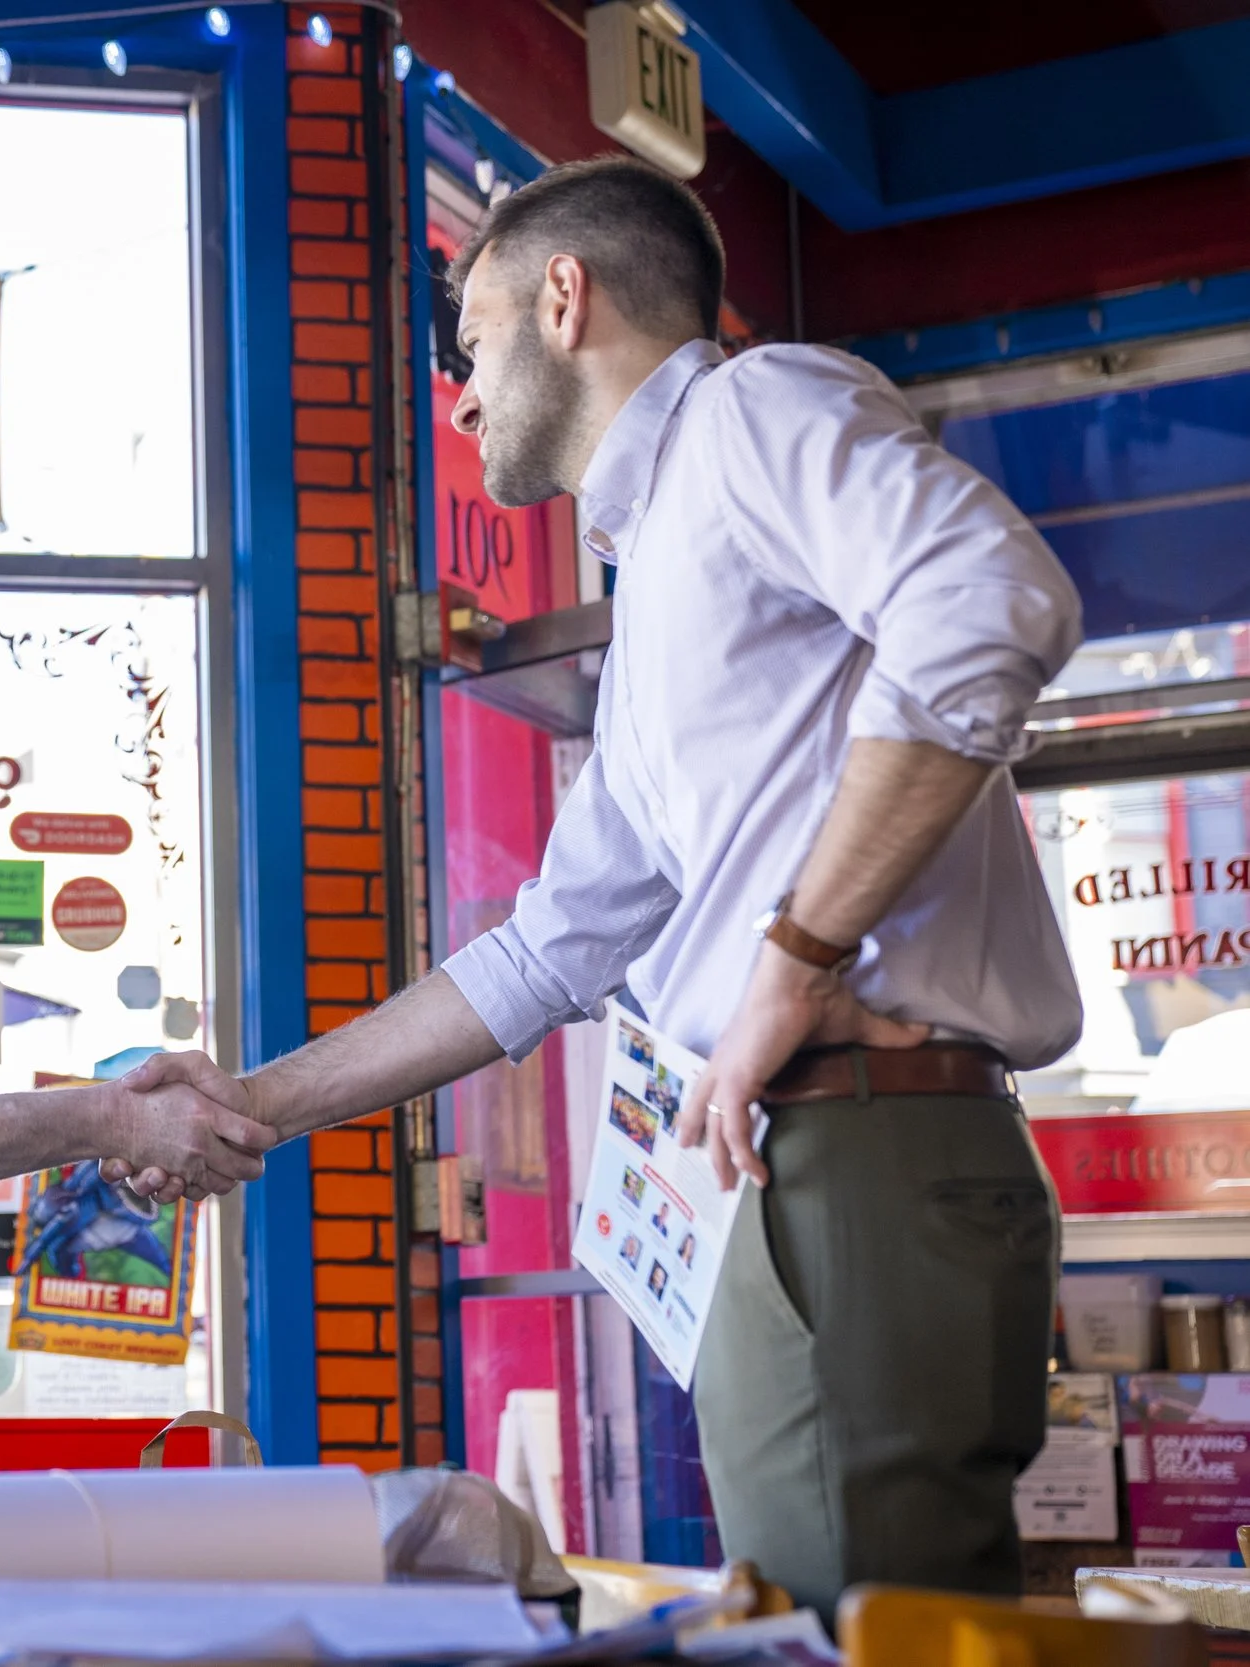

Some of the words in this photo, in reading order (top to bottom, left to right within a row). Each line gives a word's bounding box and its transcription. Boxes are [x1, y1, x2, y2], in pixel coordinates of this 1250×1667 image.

[638, 25, 691, 136] EXIT
[40, 1277, 120, 1312] WHITE
[126, 1286, 168, 1316] IPA
[1152, 1434, 1248, 1453] DRAWING
[1188, 1448, 1206, 1465] A
[1155, 1461, 1236, 1480] DECADE
